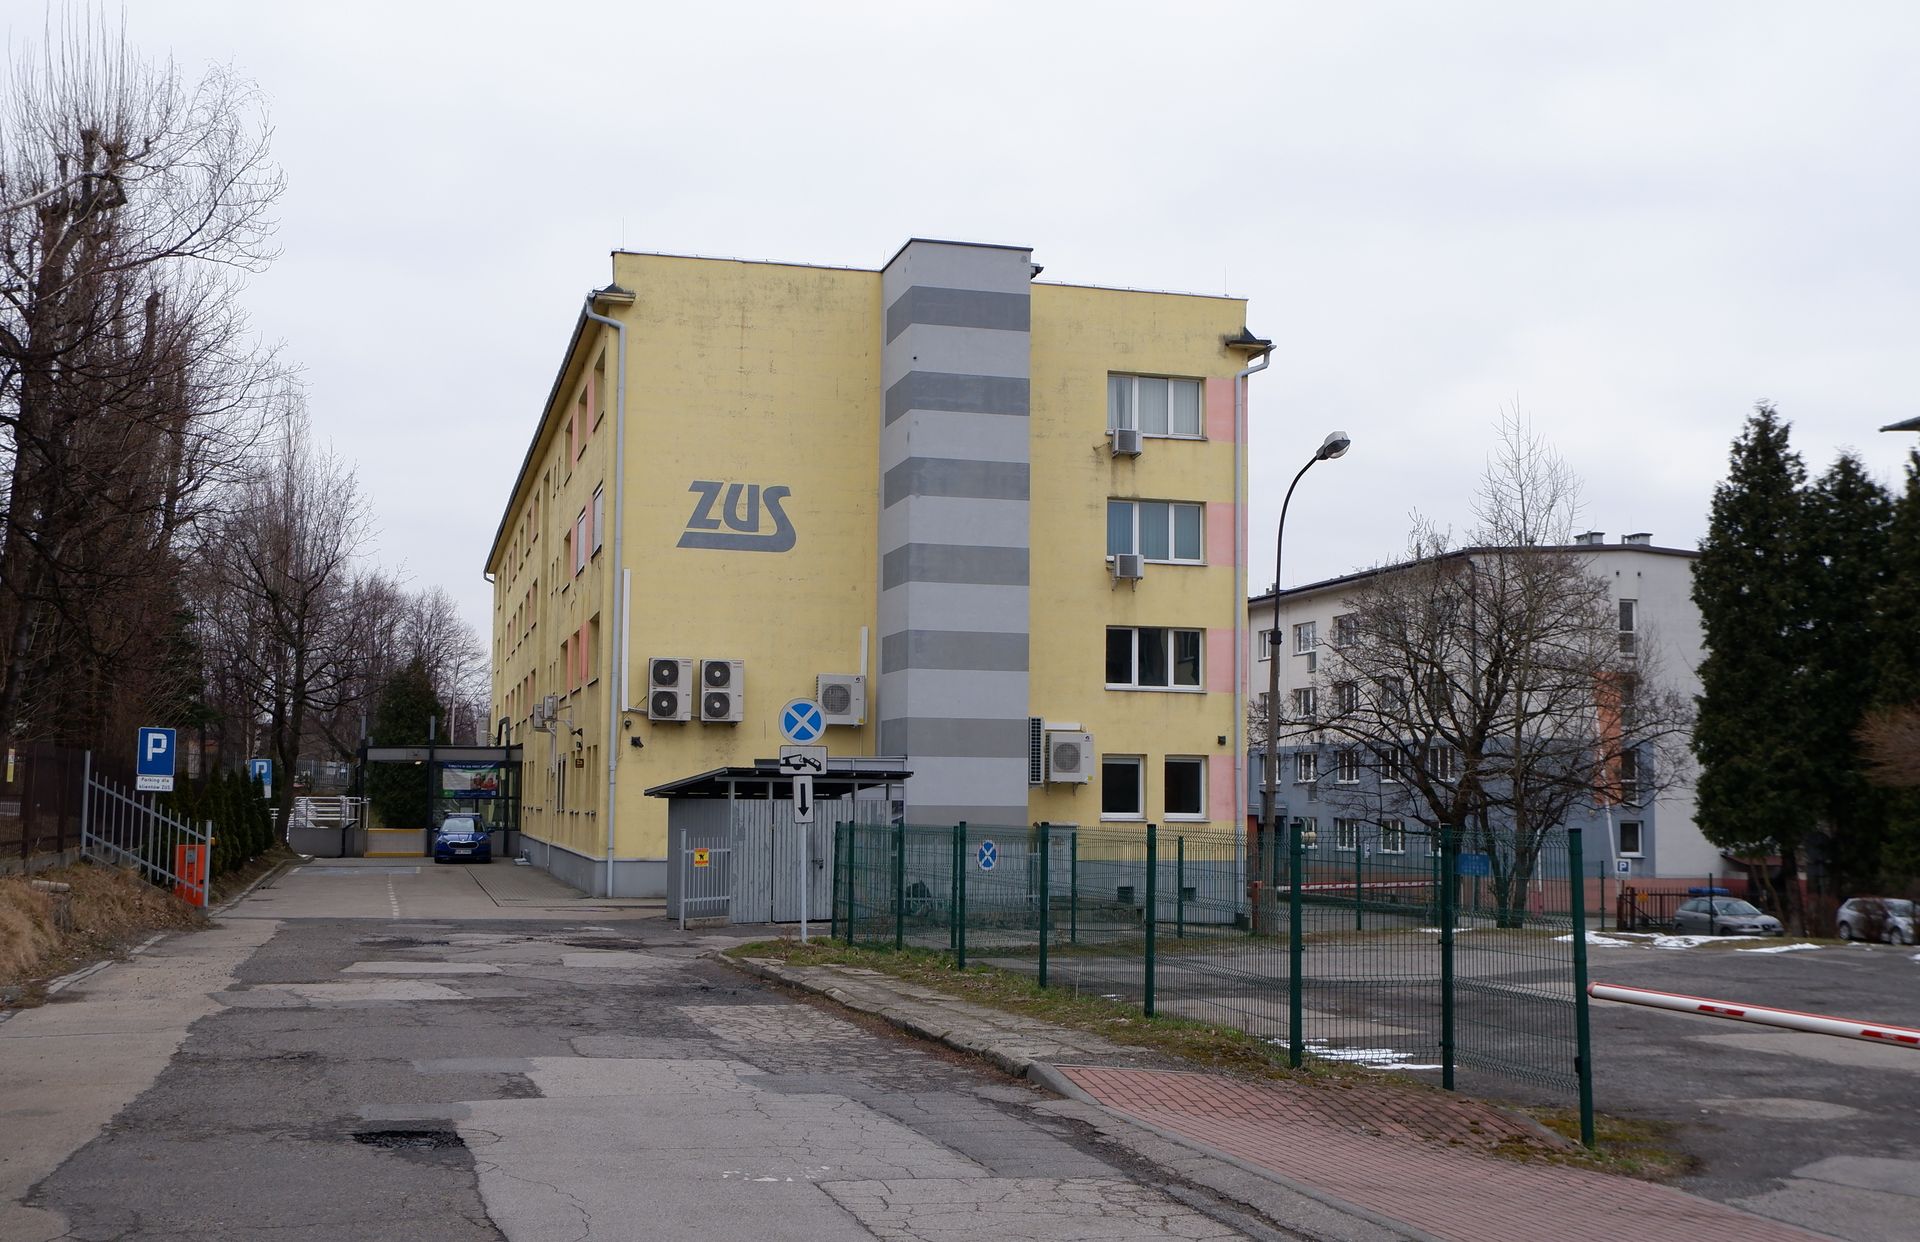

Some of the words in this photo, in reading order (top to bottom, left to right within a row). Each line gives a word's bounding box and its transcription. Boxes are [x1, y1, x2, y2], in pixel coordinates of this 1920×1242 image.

[676, 480, 797, 553] ZUS
[147, 732, 167, 761] P
[256, 761, 267, 778] P
[1619, 862, 1627, 871] P
